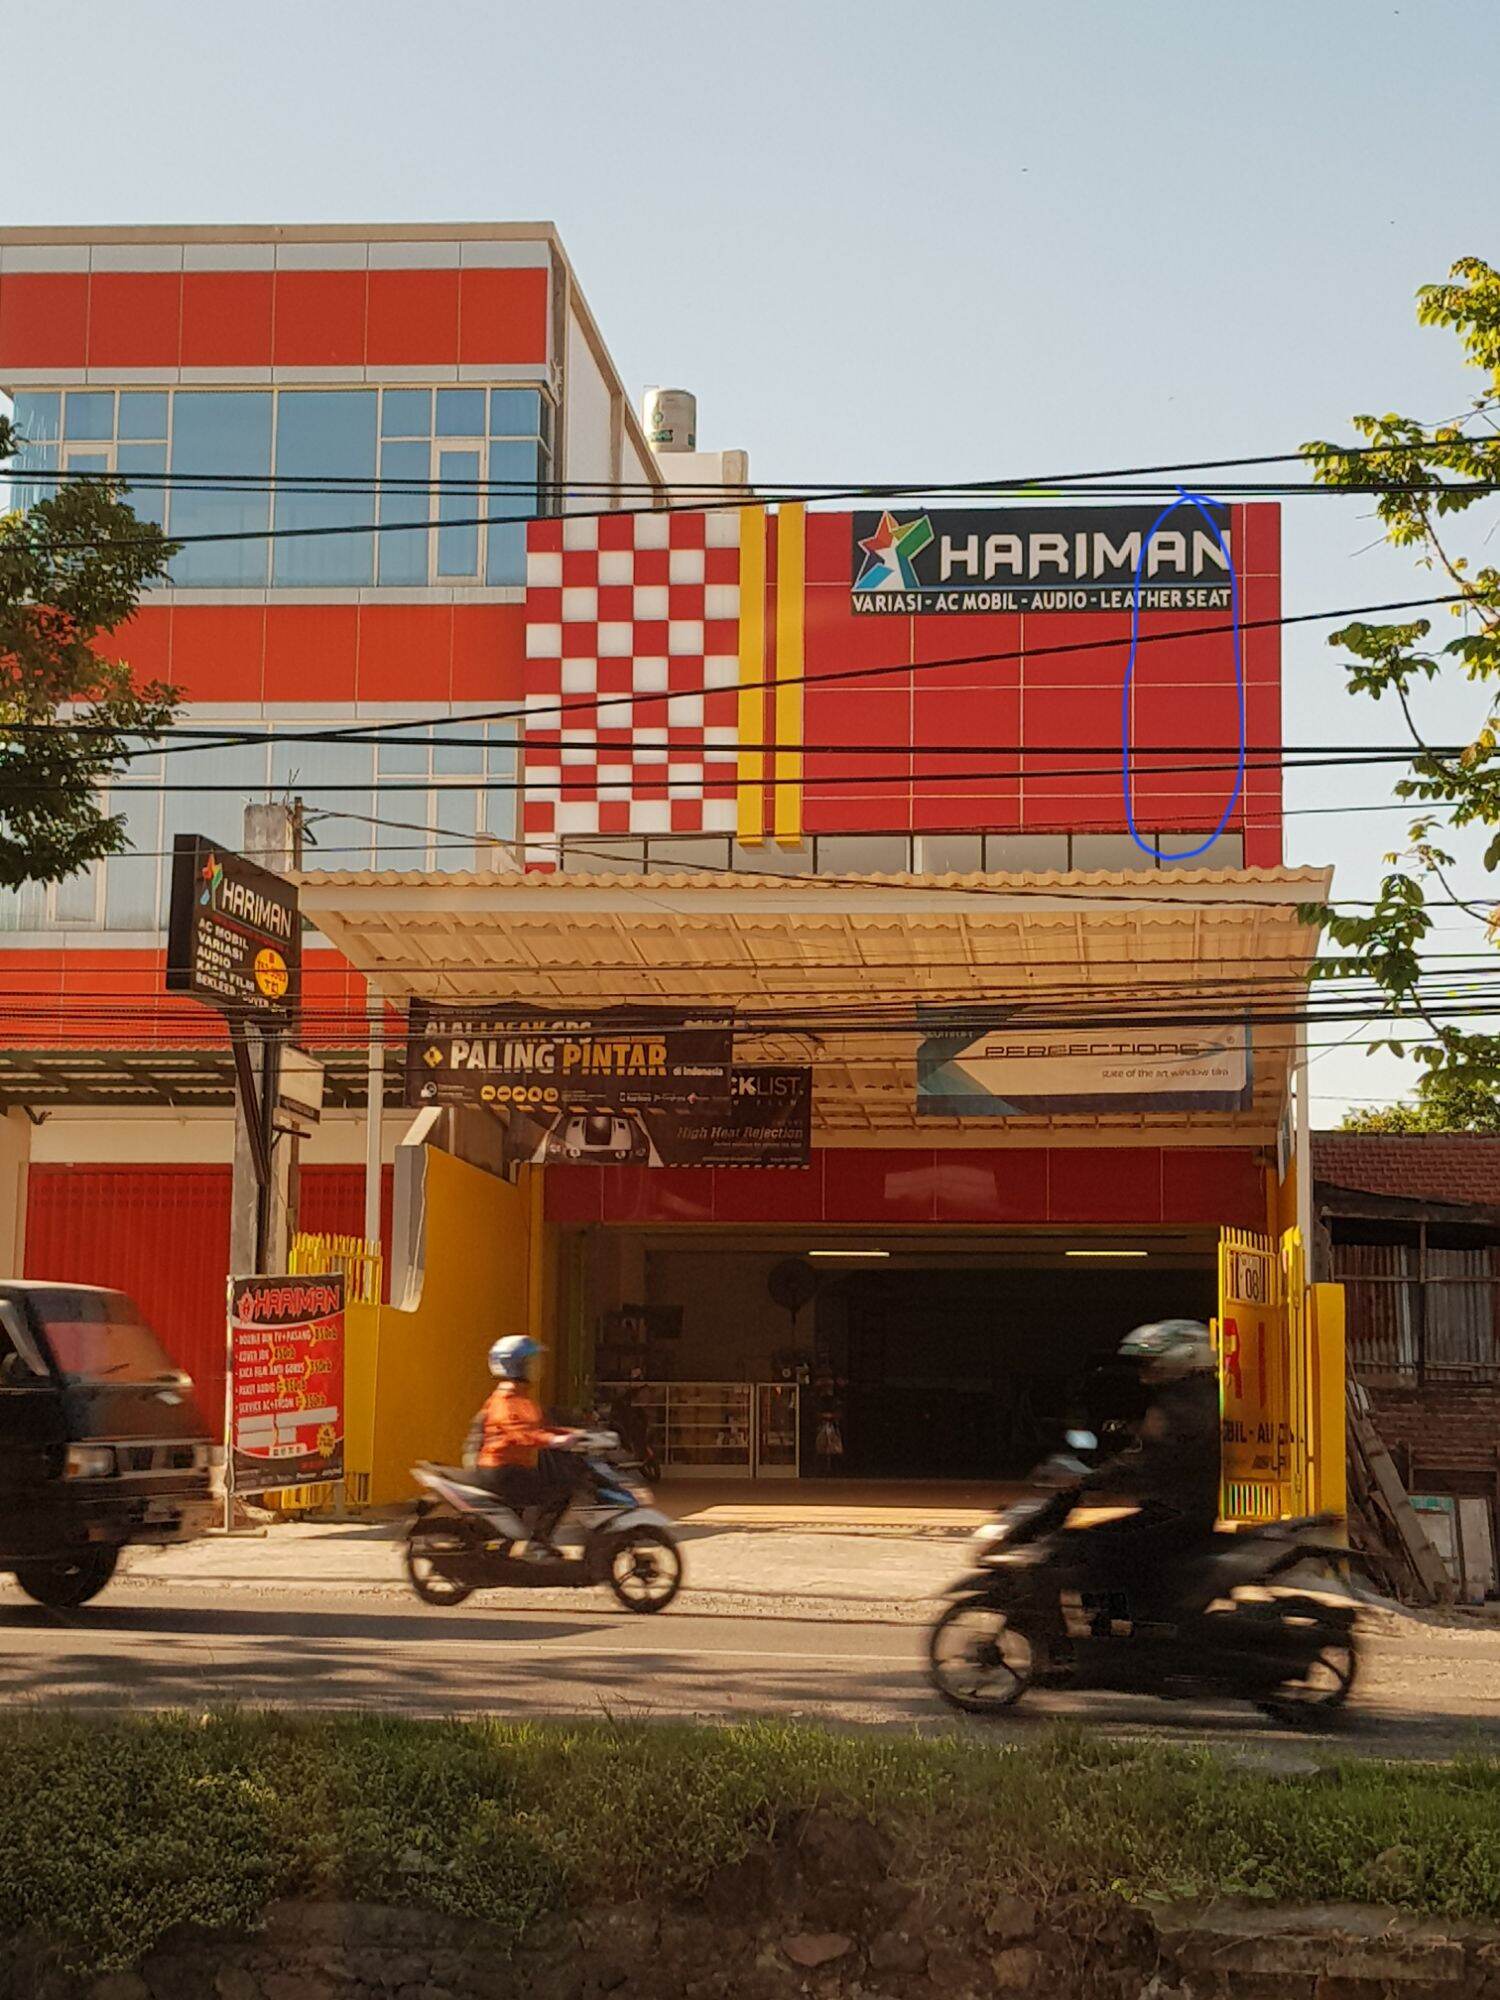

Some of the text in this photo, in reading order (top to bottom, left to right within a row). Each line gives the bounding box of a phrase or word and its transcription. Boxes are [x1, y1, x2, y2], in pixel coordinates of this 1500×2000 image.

[940, 530, 1231, 582] HARIMAN
[852, 593, 922, 613] VARIASI
[935, 592, 959, 611] AC
[962, 592, 1018, 611] MOBIL
[1031, 591, 1085, 610] AUDIO
[1101, 589, 1184, 609] LEATHER
[1186, 588, 1231, 608] SEAT
[221, 878, 292, 938] HARIMAN
[198, 931, 243, 962] VARIASI
[215, 924, 249, 950] MOBIL
[197, 947, 232, 969] AUDIO
[450, 1040, 667, 1076] PALING PINTAR
